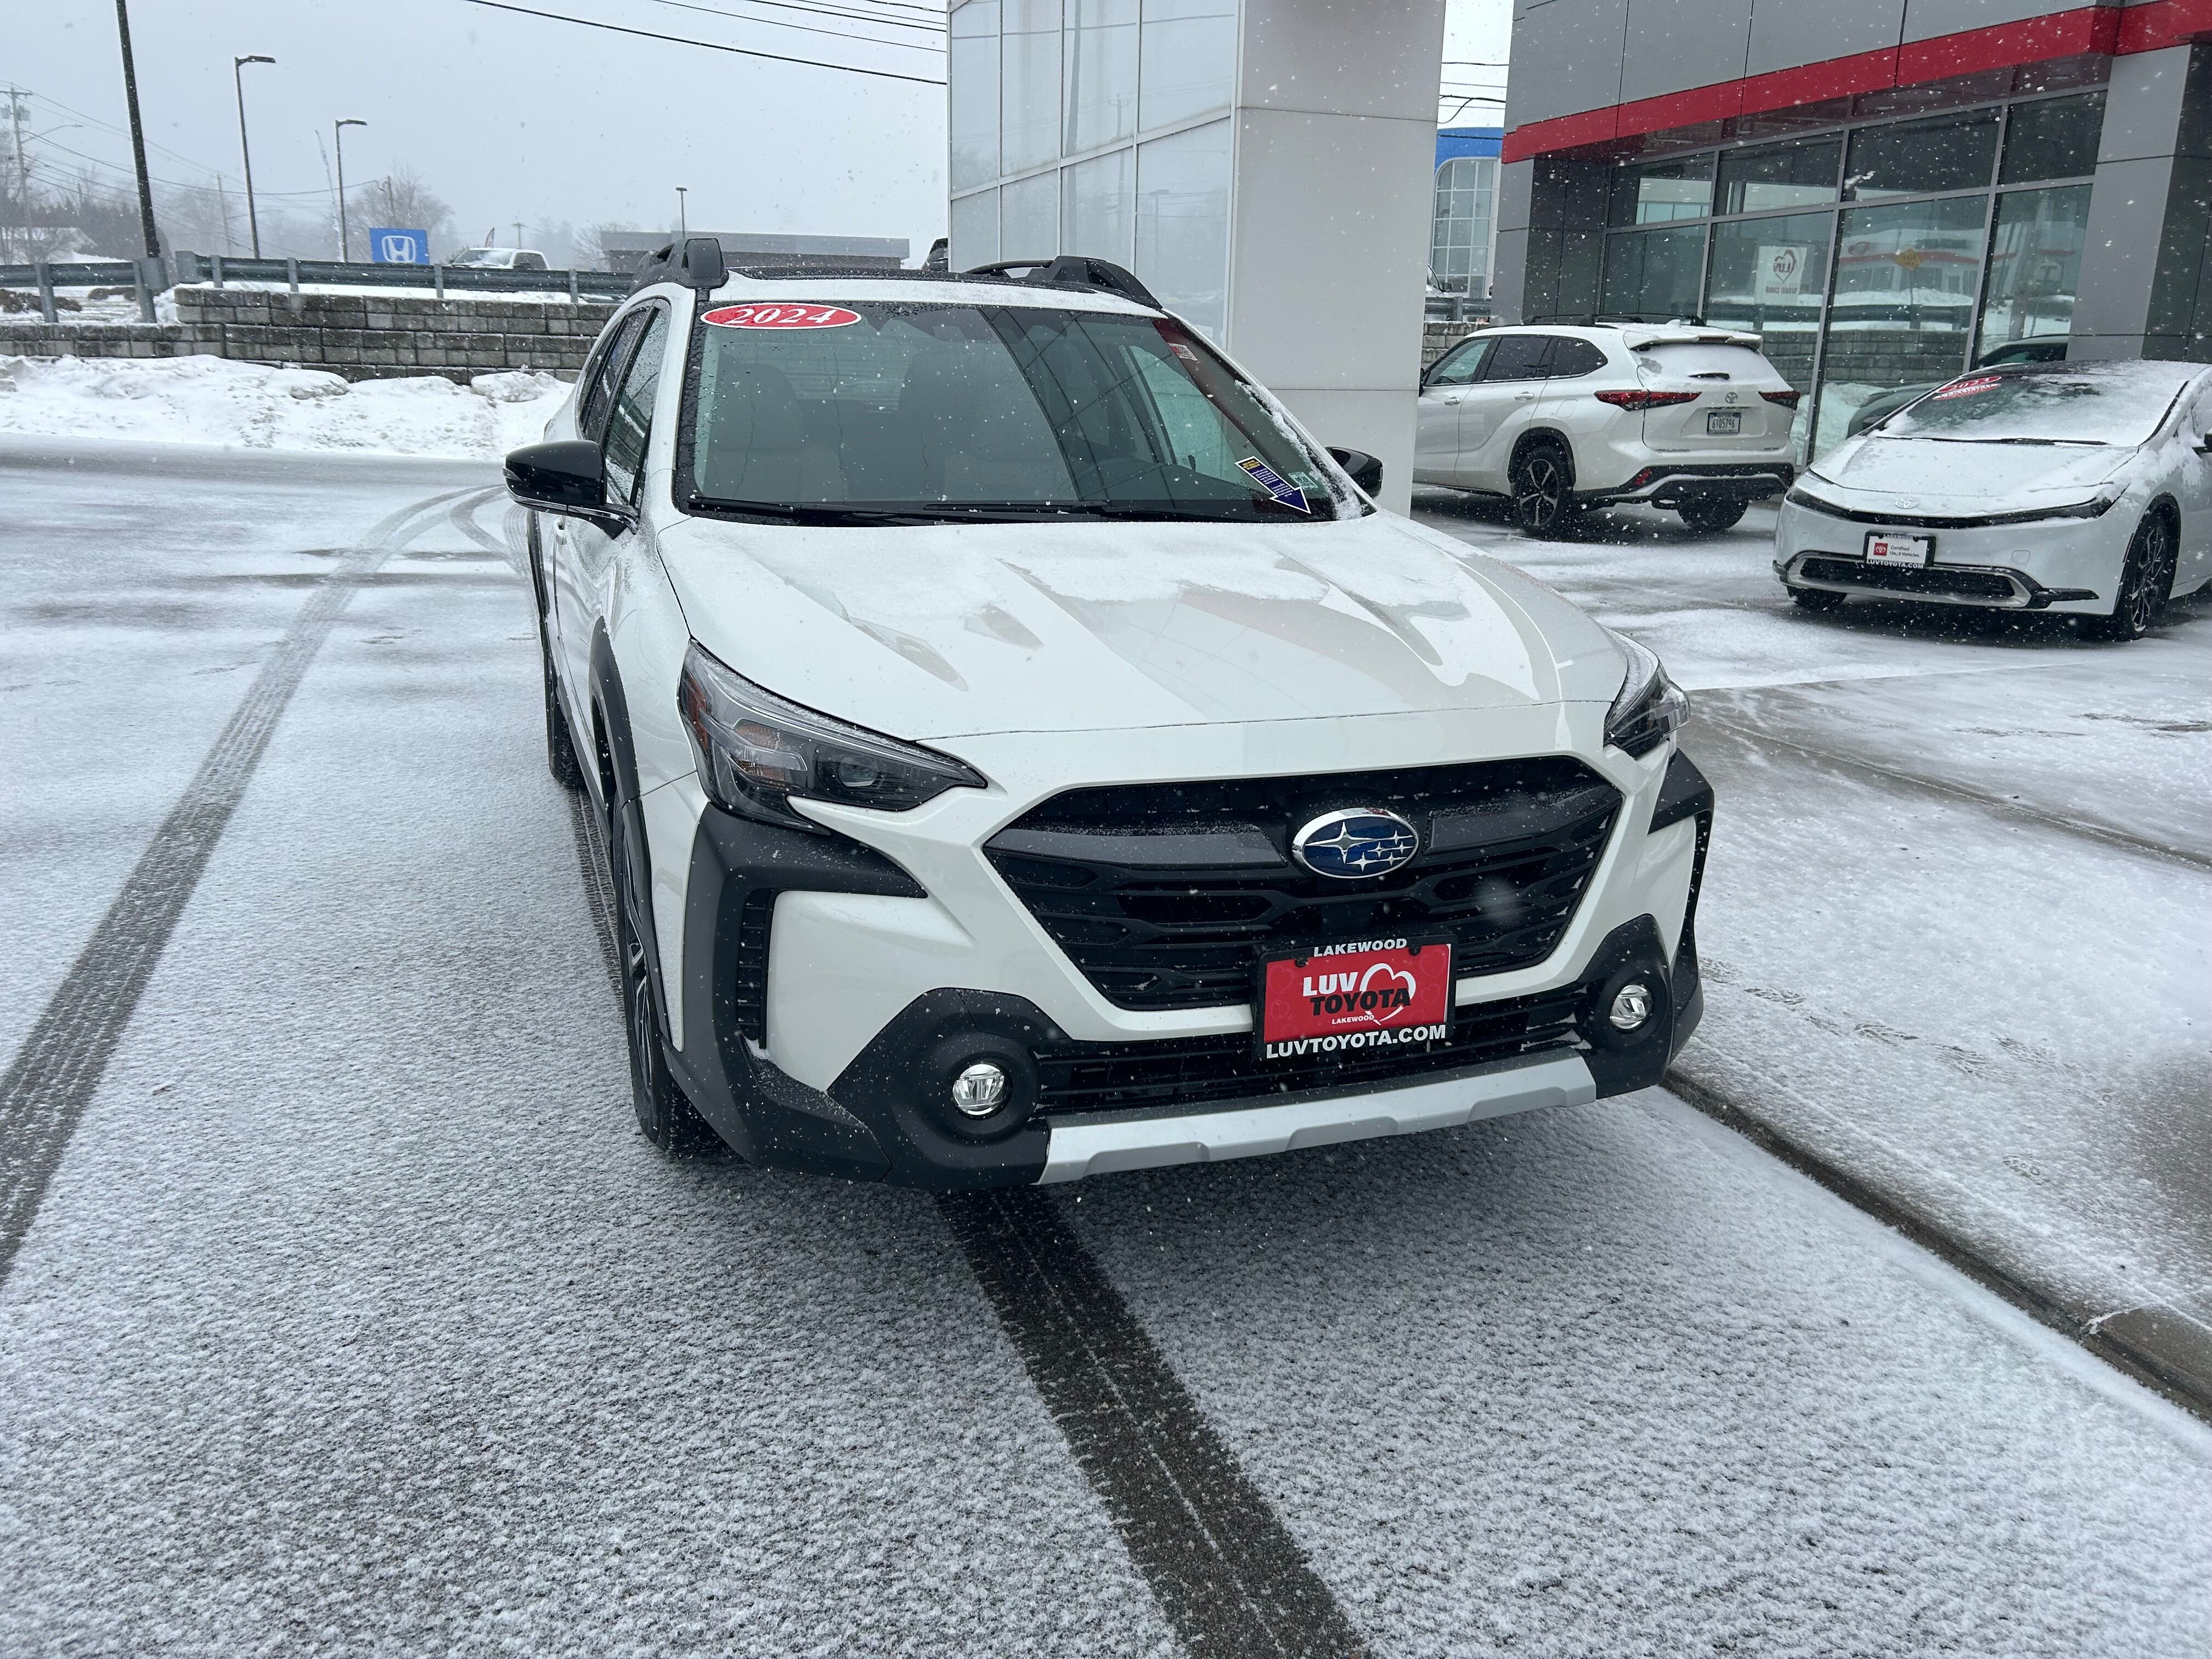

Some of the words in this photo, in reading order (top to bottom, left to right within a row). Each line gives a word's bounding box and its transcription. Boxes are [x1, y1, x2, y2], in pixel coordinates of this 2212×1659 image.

[725, 308, 837, 324] 2024
[1866, 559, 1923, 569] LUVTOYOTA.COM
[1314, 938, 1407, 957] LAKEWOOD
[1303, 972, 1358, 996] LUV
[1310, 988, 1410, 1015] TOYOTA
[1331, 1014, 1374, 1024] LAKEWOOD
[1266, 1024, 1446, 1059] LUVTOYOTA.COM
